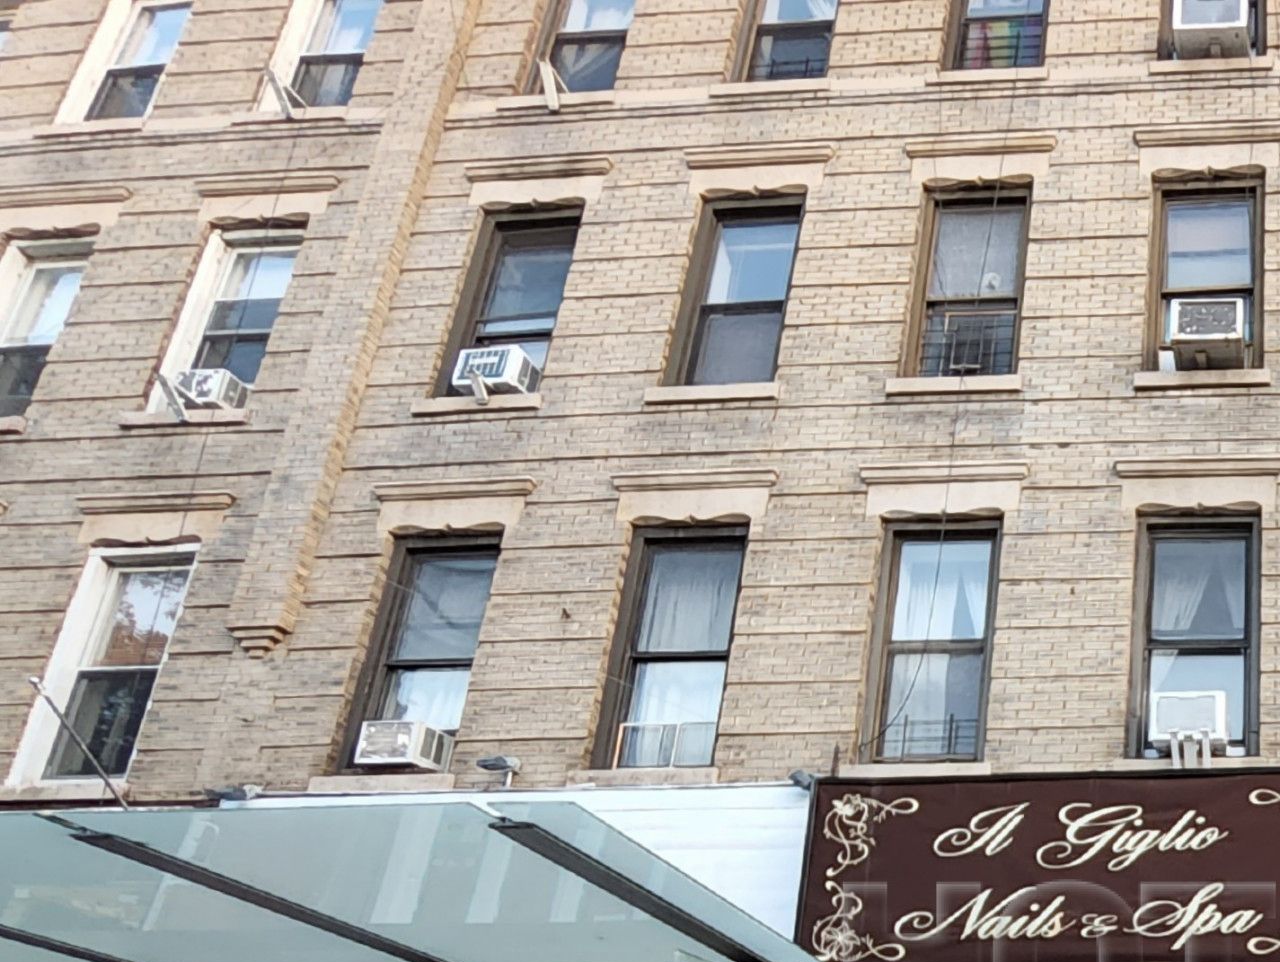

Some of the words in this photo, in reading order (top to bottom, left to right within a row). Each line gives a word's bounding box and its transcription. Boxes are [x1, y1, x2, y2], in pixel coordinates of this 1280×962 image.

[934, 801, 1030, 857] Il
[1036, 801, 1229, 873] Giglio
[893, 886, 1074, 941] Nails
[1081, 912, 1118, 935] &
[1124, 882, 1265, 950] Spa
